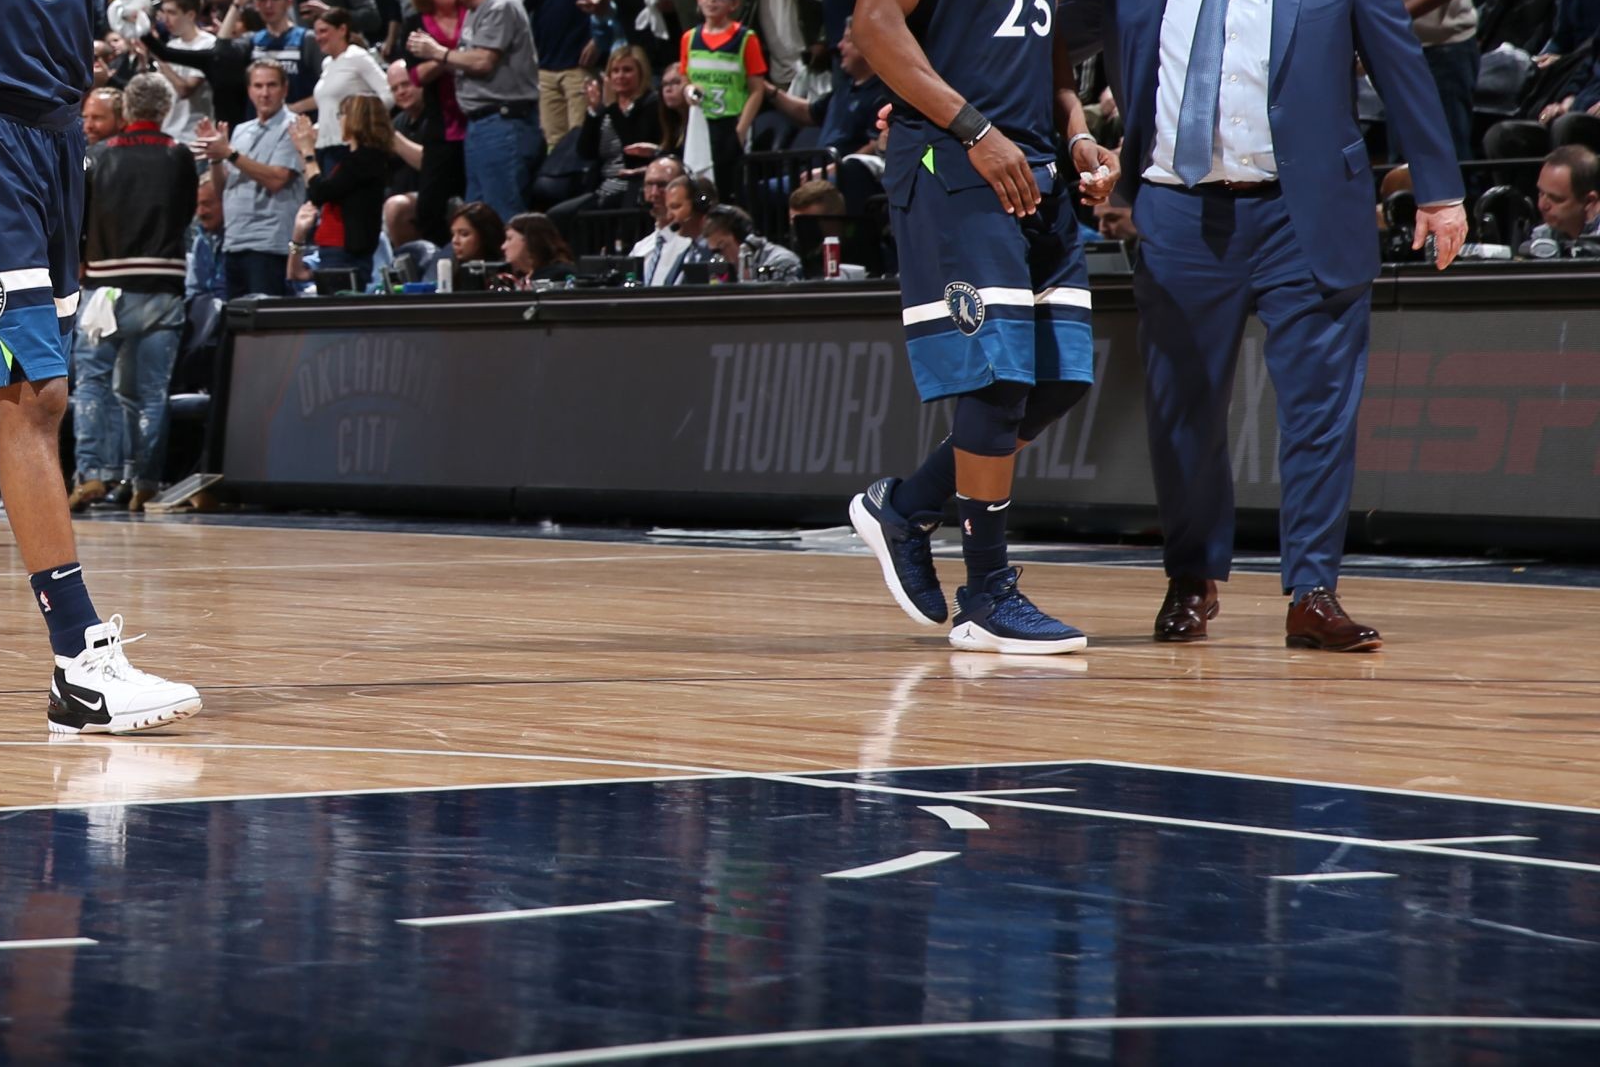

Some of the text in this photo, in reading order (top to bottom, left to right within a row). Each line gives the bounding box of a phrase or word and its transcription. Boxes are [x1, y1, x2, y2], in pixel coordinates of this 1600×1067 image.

[337, 415, 399, 474] CITY
[703, 342, 894, 474] THUNDER
[1356, 352, 1600, 475] ESP
